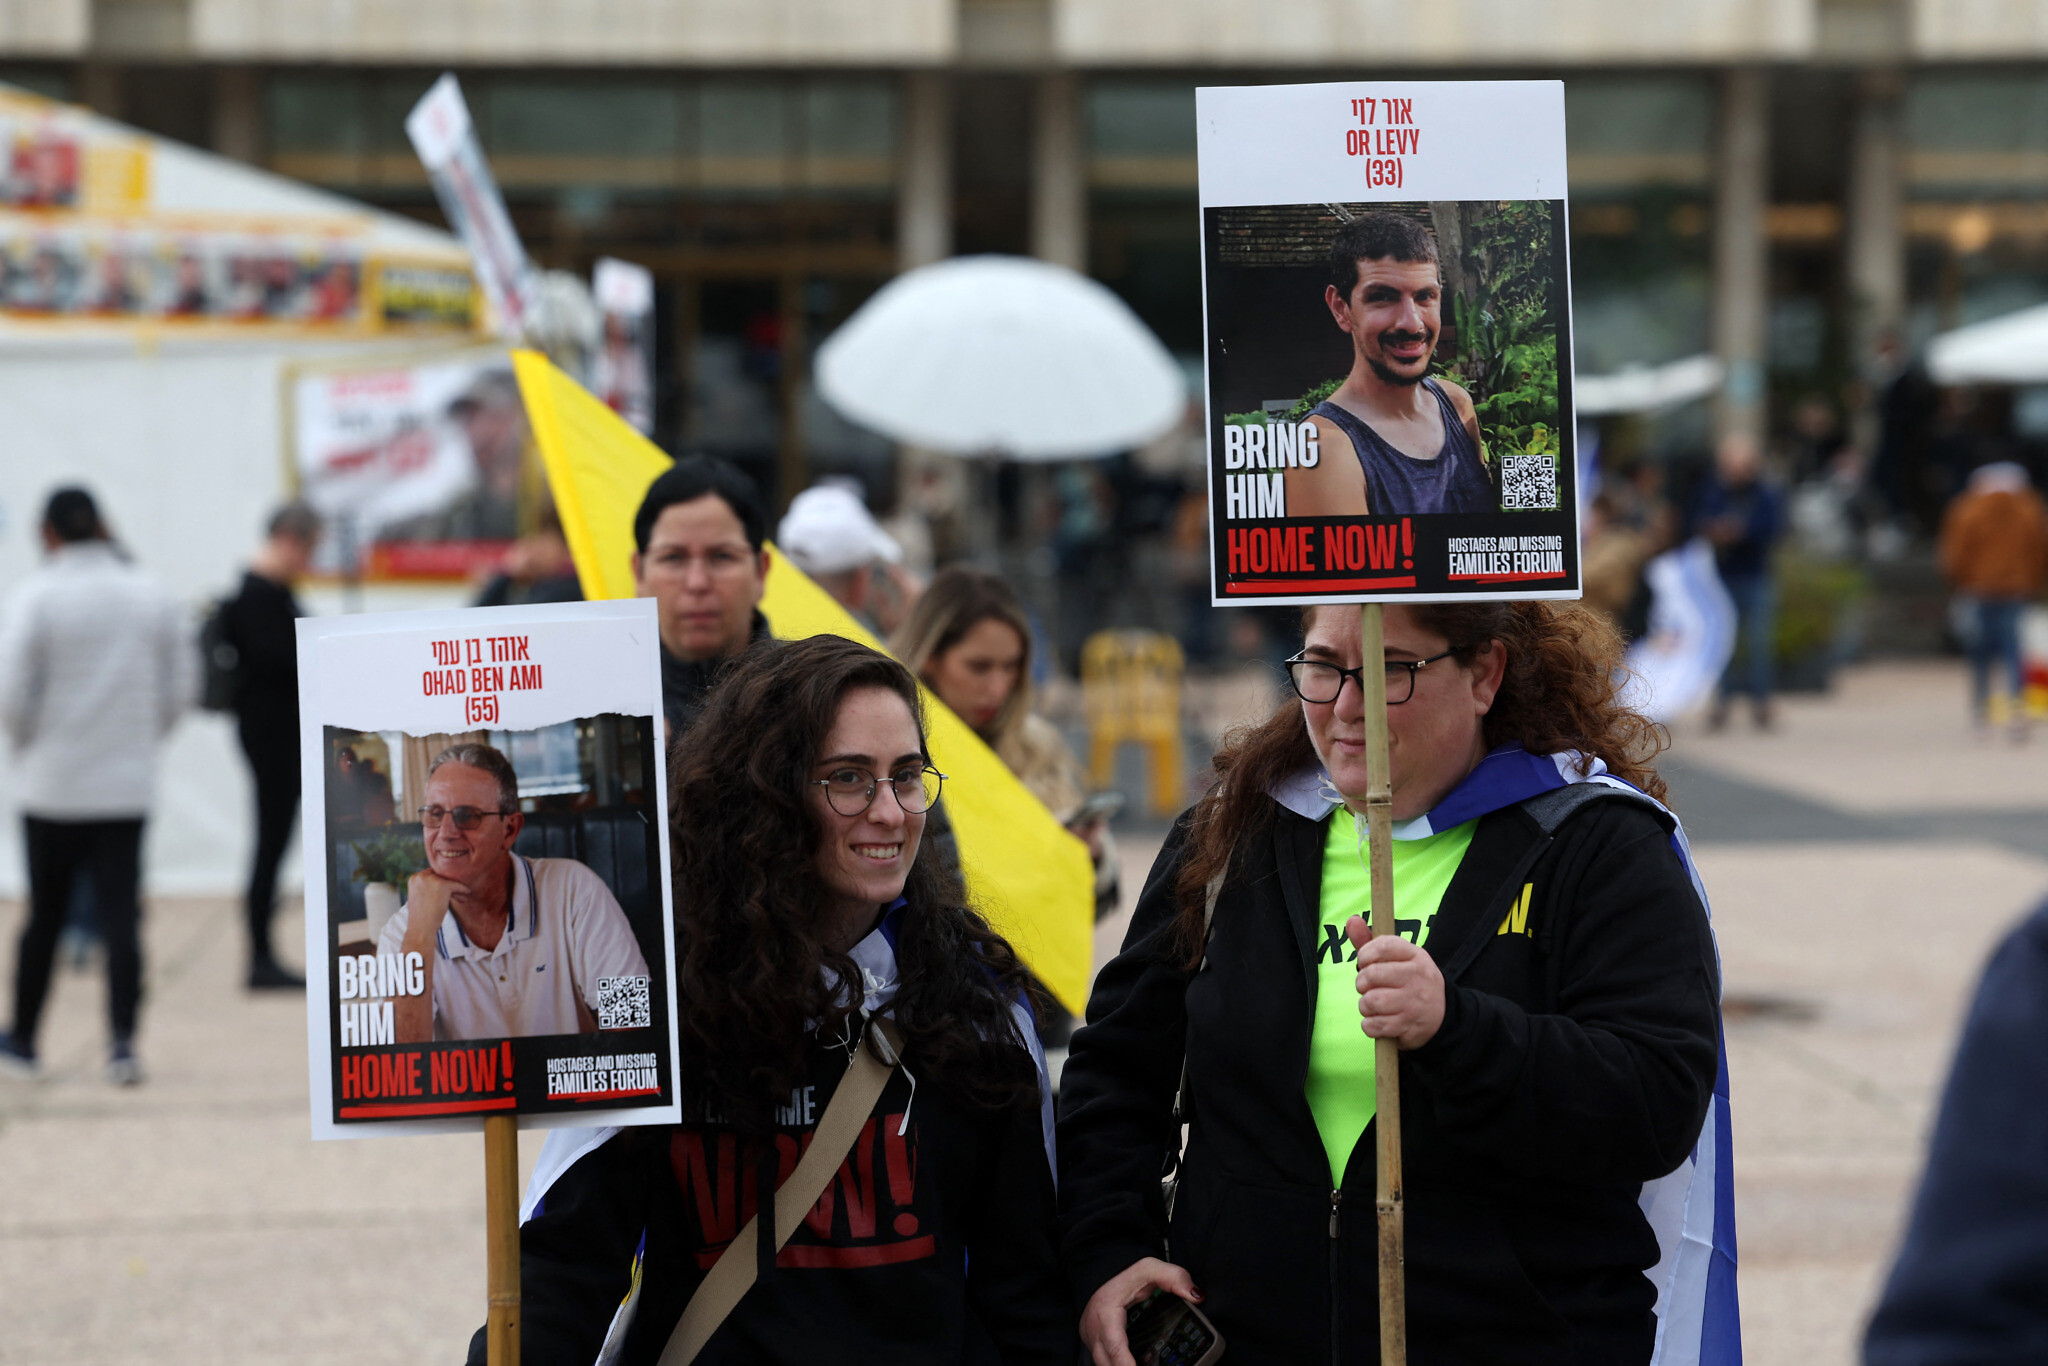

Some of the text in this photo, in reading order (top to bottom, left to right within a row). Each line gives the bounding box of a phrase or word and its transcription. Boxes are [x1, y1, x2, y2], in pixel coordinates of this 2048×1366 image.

[1351, 97, 1414, 125] אור לוי
[1346, 129, 1420, 156] OR LEVY
[1366, 157, 1403, 189] (33)
[1224, 422, 1319, 470] BRING
[1226, 473, 1286, 520] HIM
[1227, 517, 1417, 574] HOME NOW!
[1448, 535, 1562, 553] HOSTAGES AND MISSING
[1449, 551, 1563, 575] FAMILIES FORUM
[431, 635, 530, 667] אוהד בן עמי
[423, 664, 543, 696] OHAD BEN AMI
[465, 695, 499, 726] (55)
[338, 951, 425, 1000] BRING
[340, 1001, 395, 1047] HIM
[341, 1041, 515, 1099] HOME NOW!
[547, 1052, 657, 1073] HOSTAGES AND MISSING
[548, 1068, 658, 1094] FAMILIES FORUM
